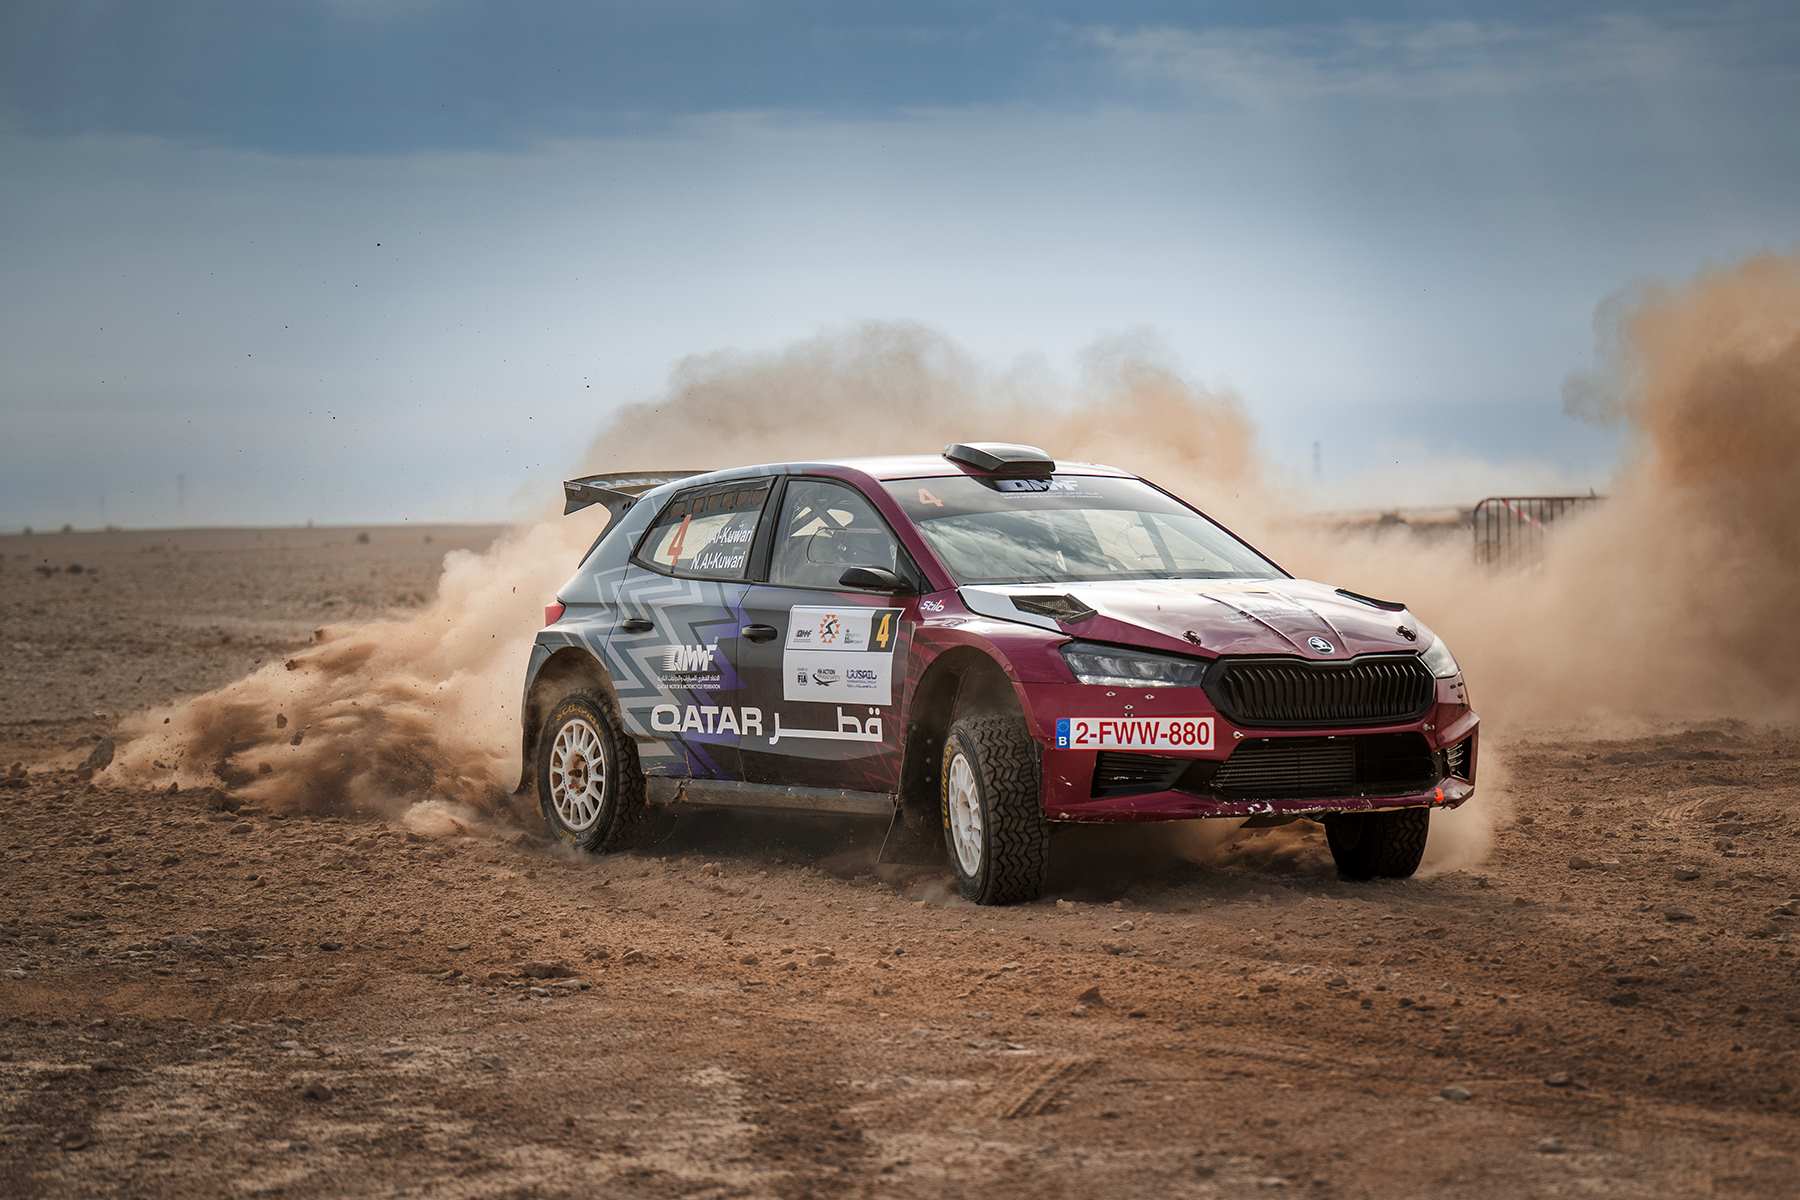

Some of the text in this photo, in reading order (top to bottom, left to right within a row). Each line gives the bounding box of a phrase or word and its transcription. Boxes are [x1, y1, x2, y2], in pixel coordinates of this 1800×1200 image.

[918, 488, 944, 507] 4
[667, 513, 692, 567] 4
[920, 600, 945, 612] Stilo
[875, 613, 892, 648] 4
[651, 704, 763, 736] QATAR
[769, 707, 883, 745] قطر
[1075, 721, 1210, 746] 2-FWW-880
[1058, 736, 1067, 746] B
